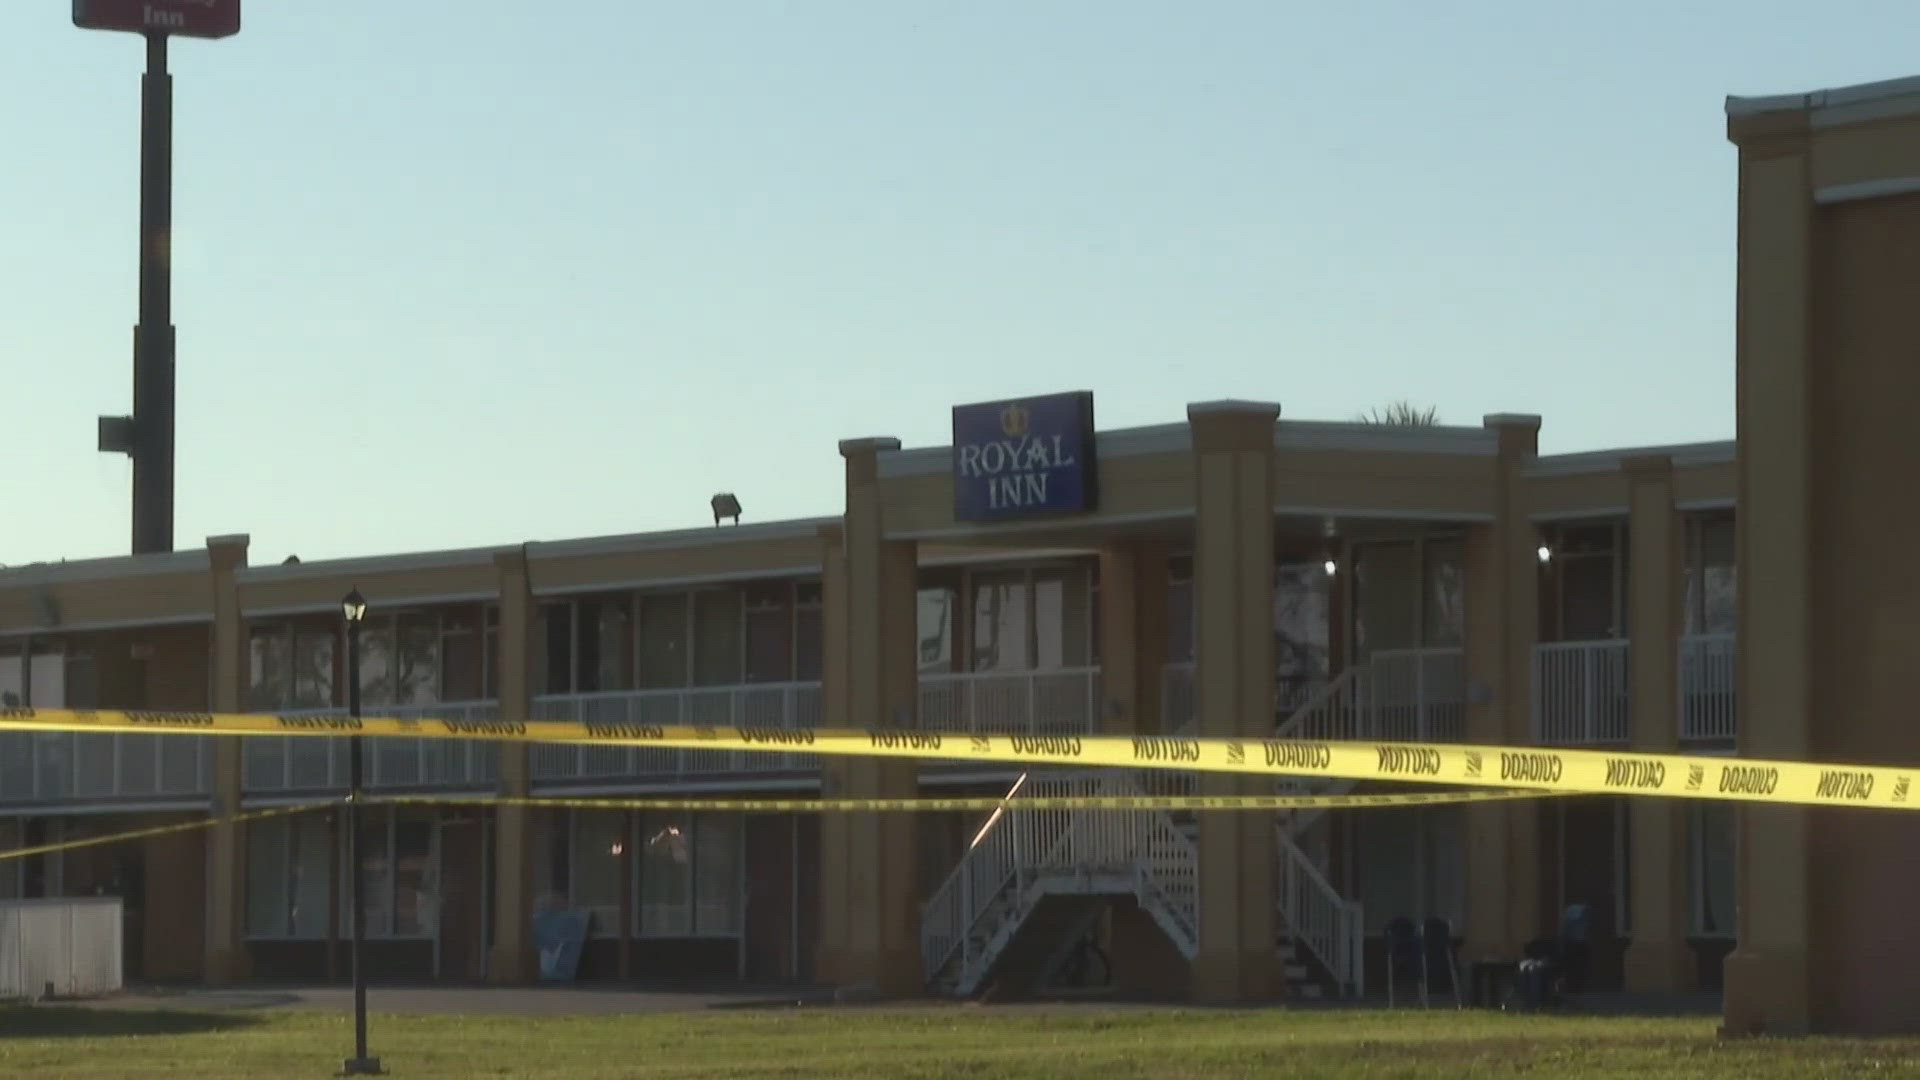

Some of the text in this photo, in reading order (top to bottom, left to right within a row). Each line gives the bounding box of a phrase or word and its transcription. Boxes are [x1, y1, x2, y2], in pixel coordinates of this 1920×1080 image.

[143, 5, 184, 25] Inn
[960, 433, 1075, 478] ROYAL
[989, 473, 1049, 508] INN
